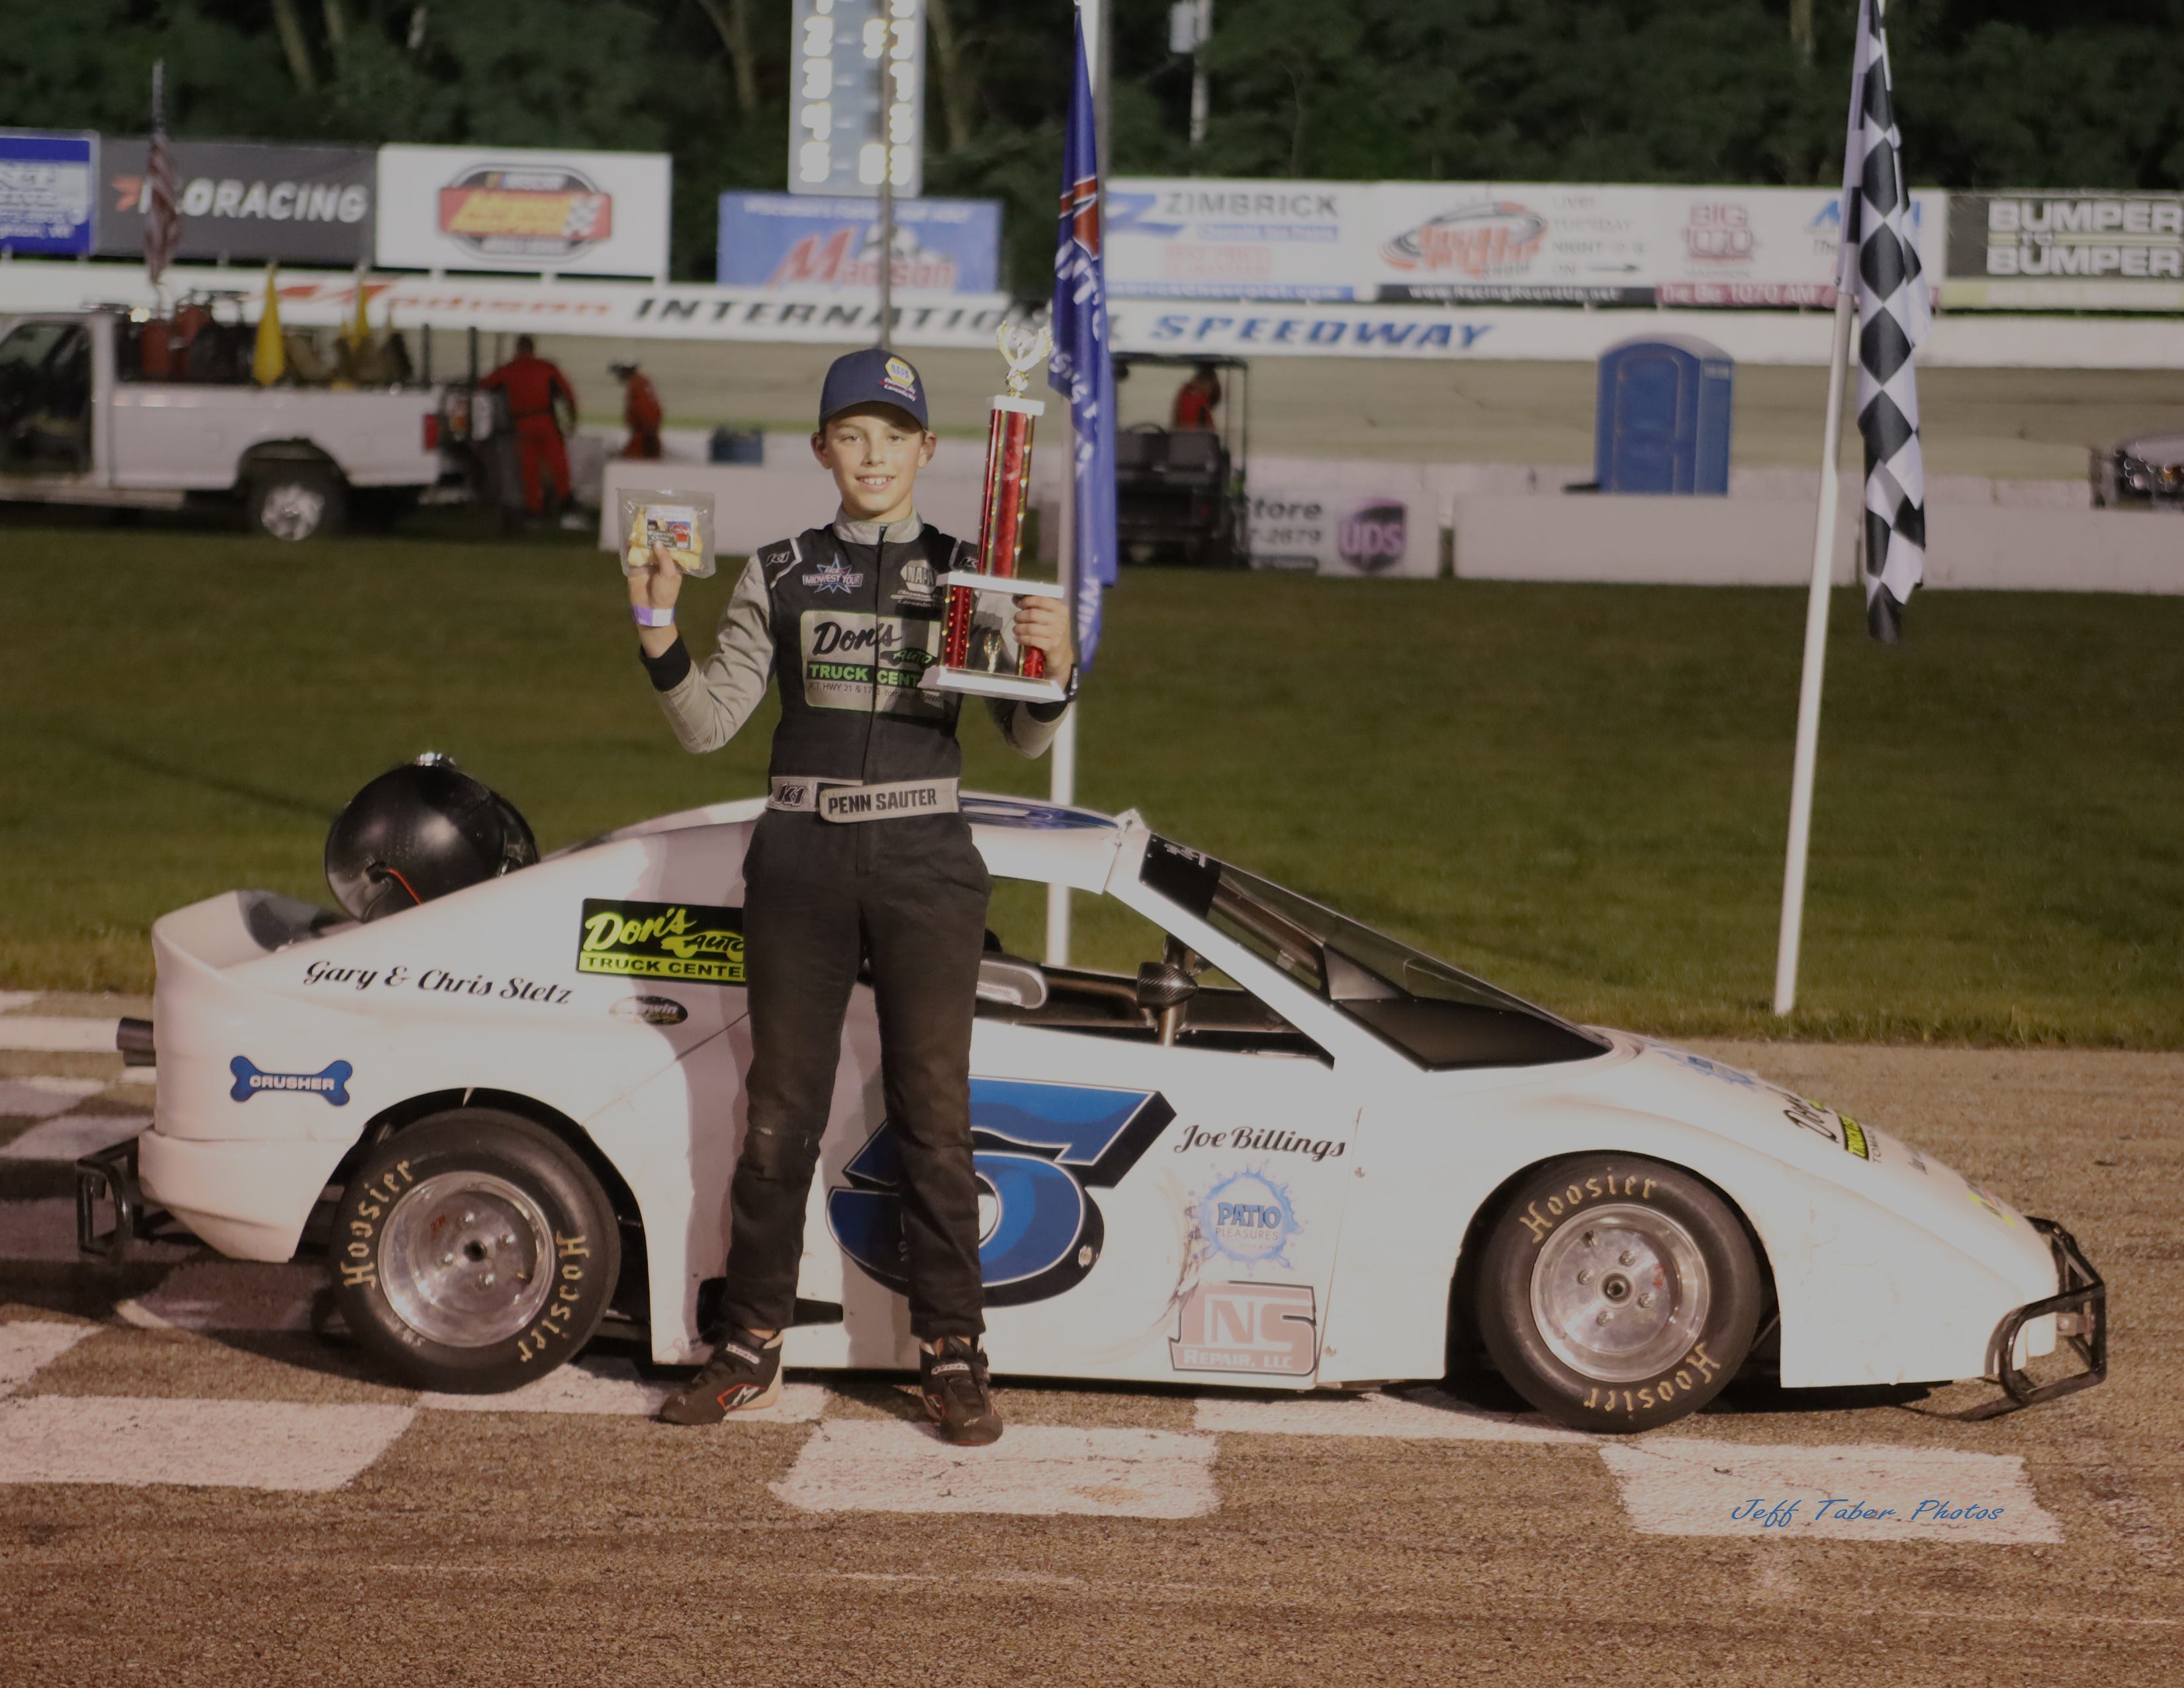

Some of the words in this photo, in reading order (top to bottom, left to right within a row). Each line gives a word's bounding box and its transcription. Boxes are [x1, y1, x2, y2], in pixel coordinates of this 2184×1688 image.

[138, 177, 369, 224] ORACING
[1163, 191, 1339, 218] ZIMBRICK
[1987, 200, 2183, 234] BUMPER
[766, 226, 957, 290] Madson
[1986, 245, 2183, 277] BUMPER
[634, 297, 1121, 341] INTERNATIOL
[1149, 314, 1496, 350] SPEEDWAY
[890, 363, 911, 381] NAPA
[1253, 498, 1322, 520] tore
[905, 566, 935, 586] NAPA
[959, 556, 978, 569] K
[805, 574, 841, 585] MIDWEST
[842, 574, 860, 585] TOUR
[812, 622, 903, 655] Don's
[892, 650, 933, 664] AUTO
[809, 664, 869, 682] TRUCK
[876, 670, 921, 688] CENT
[828, 794, 872, 815] PENN
[876, 788, 937, 810] SAUTER
[582, 906, 698, 952] Don's
[302, 960, 379, 990] Gary
[383, 964, 410, 988] &
[417, 967, 493, 997] Chris
[586, 956, 660, 972] TRUCK
[668, 961, 745, 978] CENTE
[249, 1074, 335, 1092] CRUSHER
[1173, 1124, 1227, 1153] Joe
[1231, 1125, 1346, 1162] Billings
[1217, 1202, 1282, 1229] PATIO
[1520, 1166, 1659, 1244] Hoosier
[340, 1160, 413, 1290] Hoosier
[1215, 1227, 1279, 1241] PLEASURES
[518, 1229, 590, 1363] Hoosier
[1263, 1355, 1293, 1370] LLC
[1583, 1341, 1721, 1421] Hoosier
